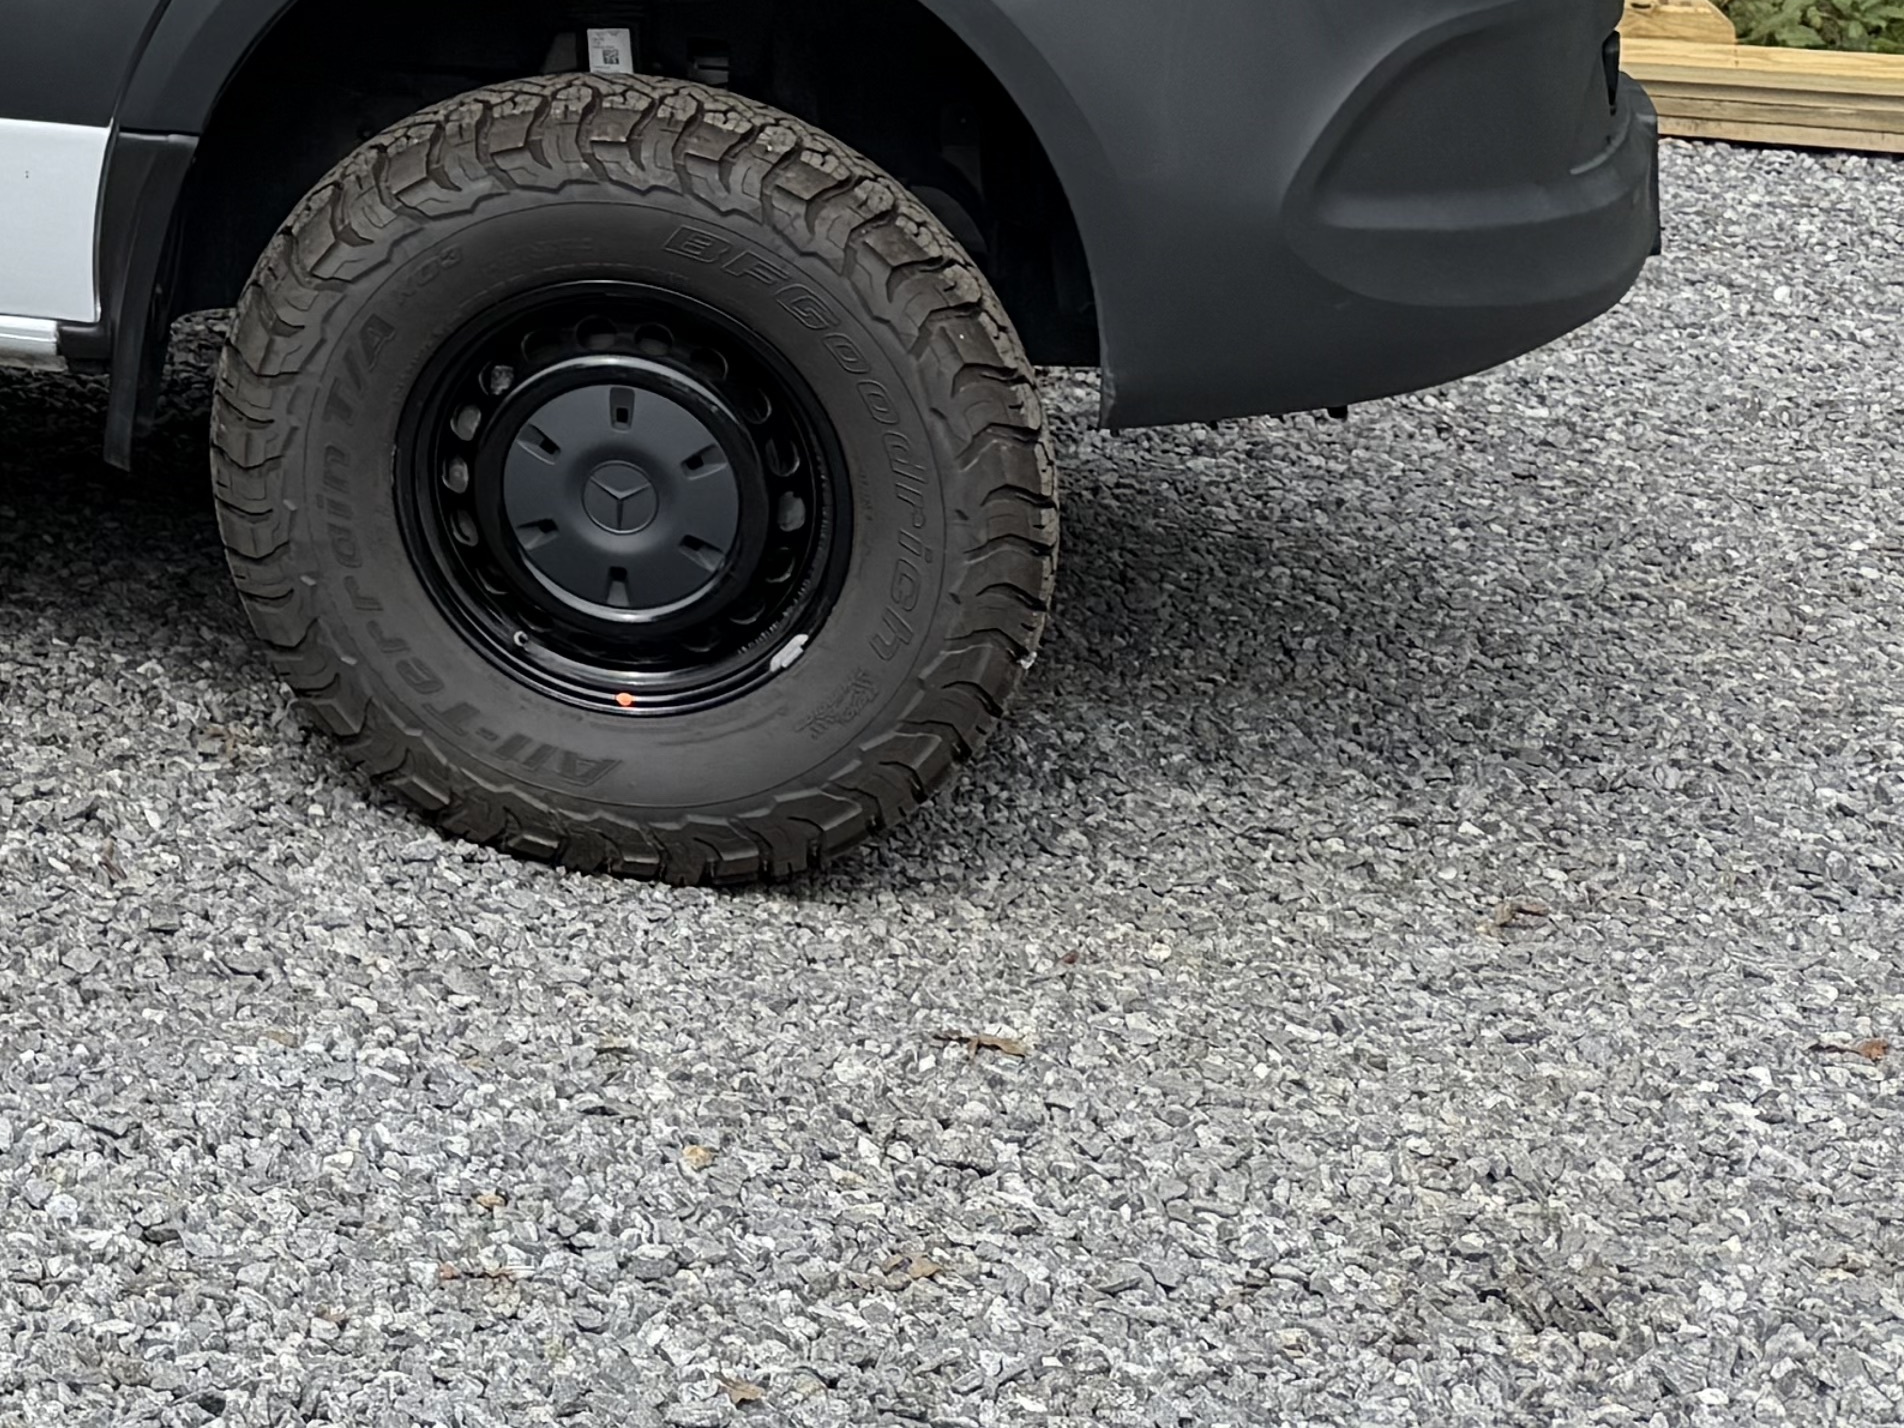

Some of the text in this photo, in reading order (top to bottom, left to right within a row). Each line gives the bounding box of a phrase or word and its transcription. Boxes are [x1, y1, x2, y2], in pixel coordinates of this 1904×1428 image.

[322, 312, 398, 428] T/A
[662, 223, 934, 663] BFGoodrich
[315, 443, 624, 789] All-Terrain
